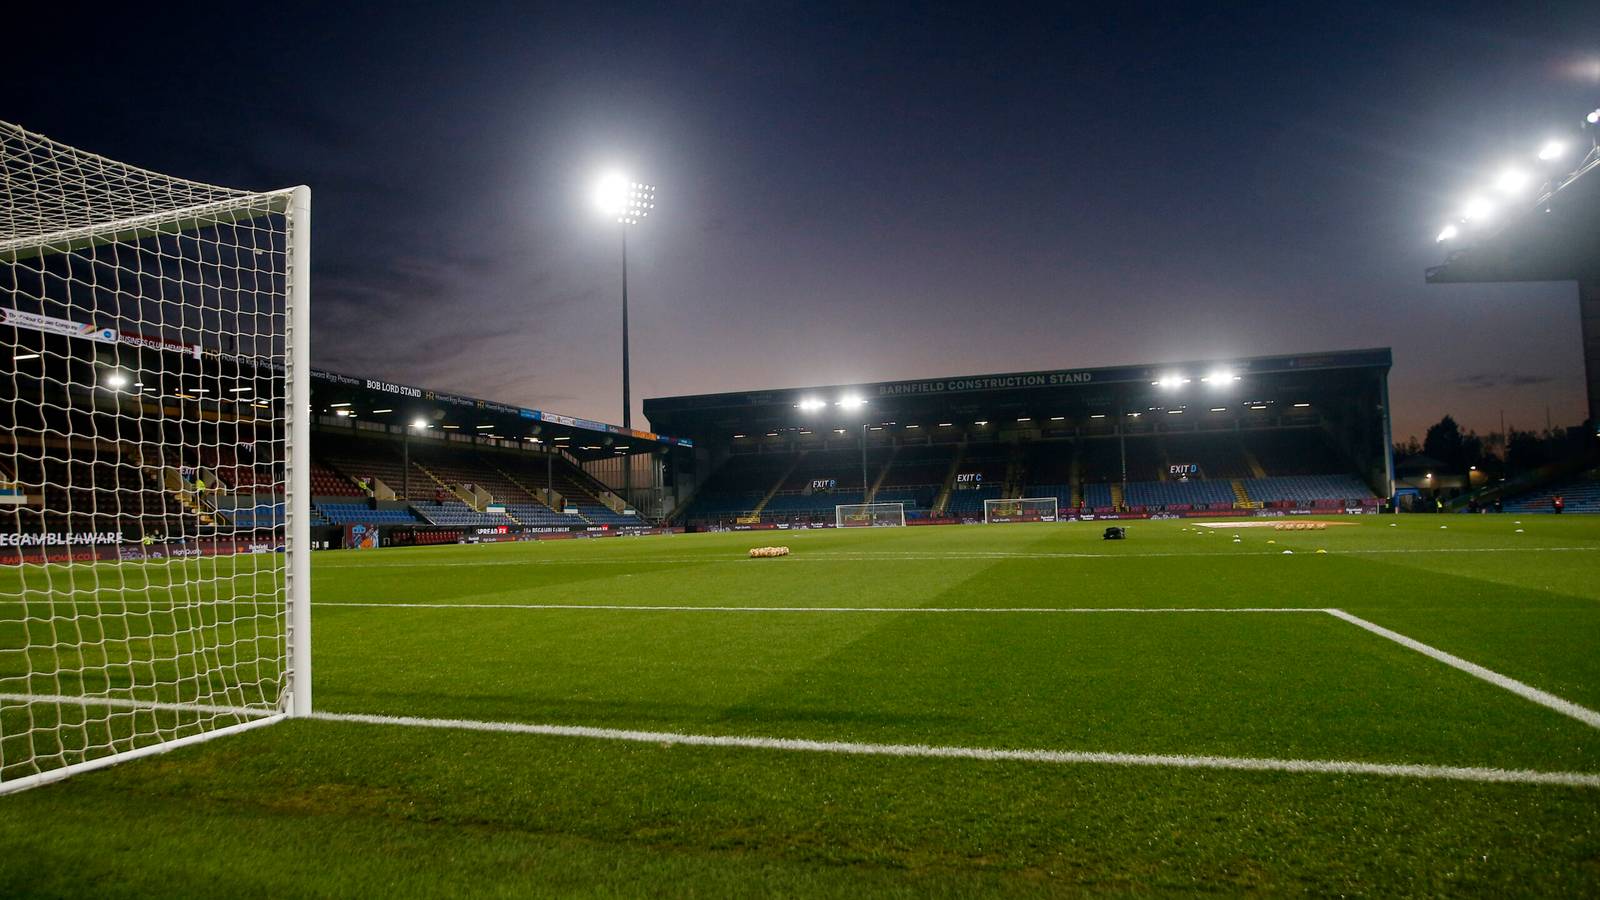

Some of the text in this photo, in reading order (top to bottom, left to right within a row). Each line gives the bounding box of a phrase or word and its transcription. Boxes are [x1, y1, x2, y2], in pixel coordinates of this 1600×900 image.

[55, 321, 78, 330] Compny
[879, 372, 1092, 395] BARNFIELD CONSTRUCTION STAND
[366, 379, 421, 398] BOB LORD STAND
[181, 467, 195, 475] EXIT
[1170, 464, 1197, 473] EXIT D
[957, 473, 982, 482] EXIT C
[812, 480, 829, 488] EXIT
